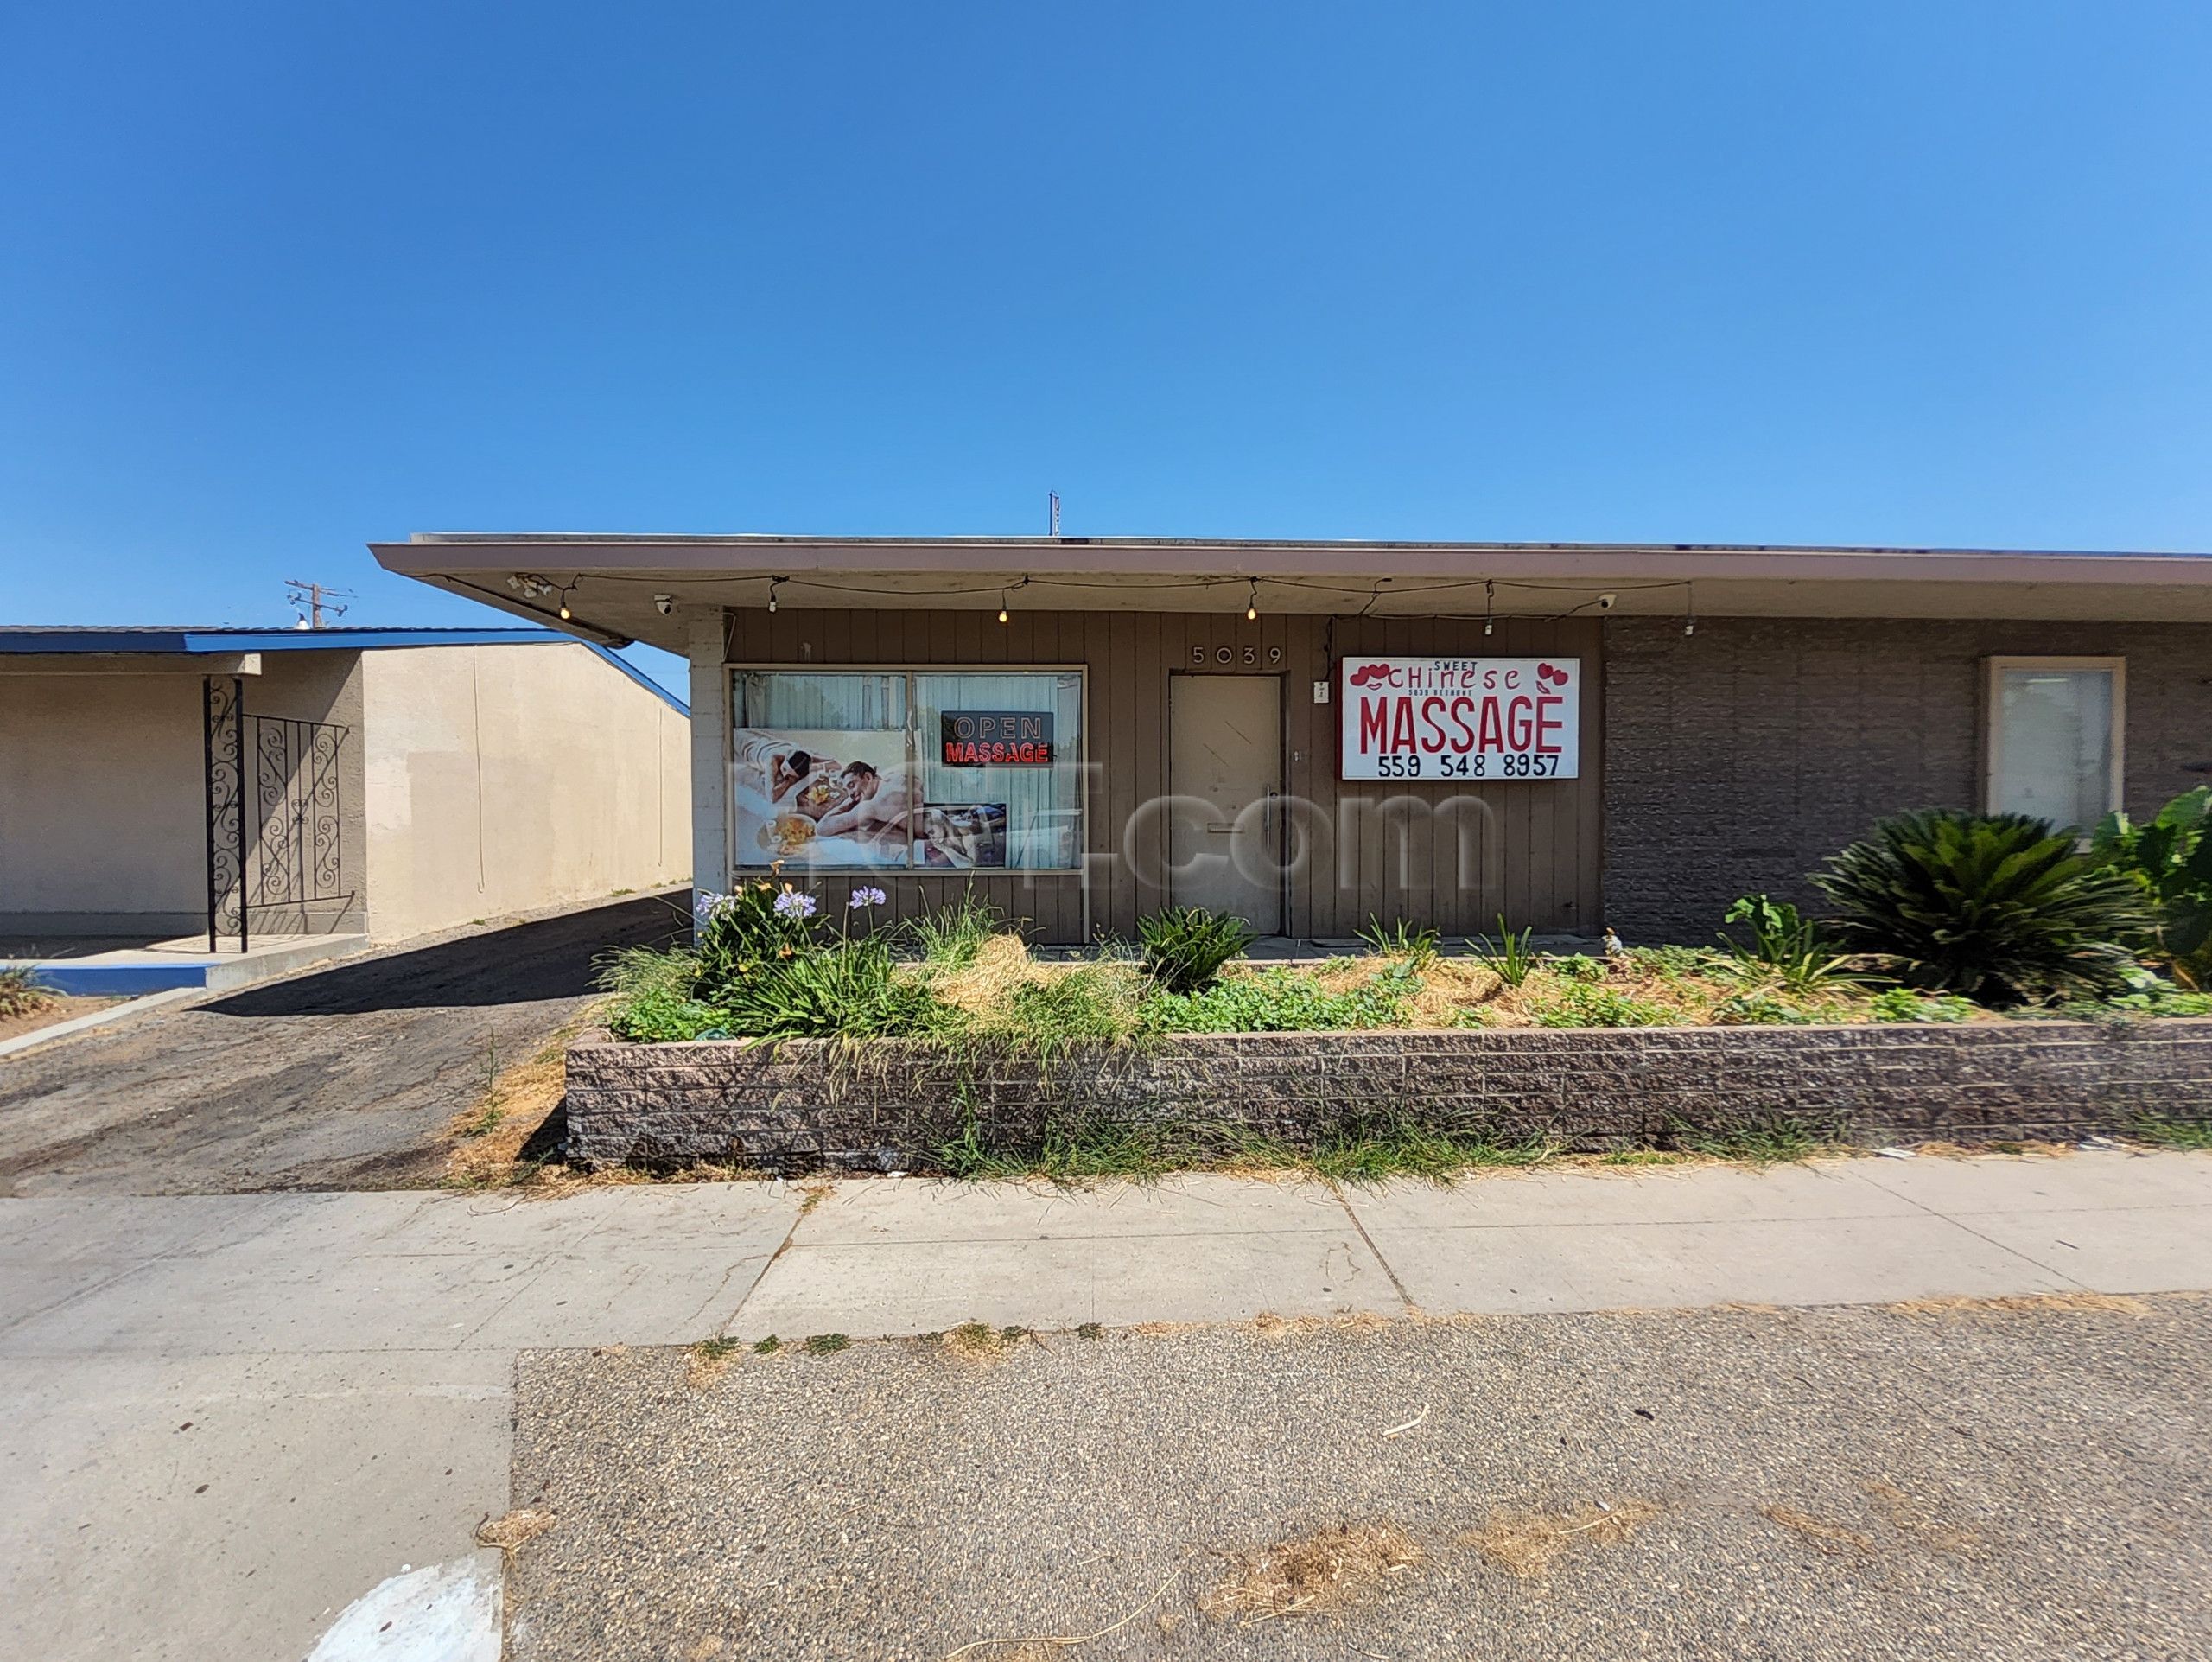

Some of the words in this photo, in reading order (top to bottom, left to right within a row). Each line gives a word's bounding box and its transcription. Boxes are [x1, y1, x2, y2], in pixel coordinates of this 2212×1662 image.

[1192, 646, 1281, 665] 5039
[1434, 660, 1478, 673] SWEET
[953, 716, 1041, 739] OPEN
[1359, 695, 1564, 755] MASSAGE
[945, 742, 1049, 762] MASSAGE
[1378, 755, 1421, 777] 559
[1440, 755, 1486, 777] 548
[1503, 754, 1560, 777] 8957
